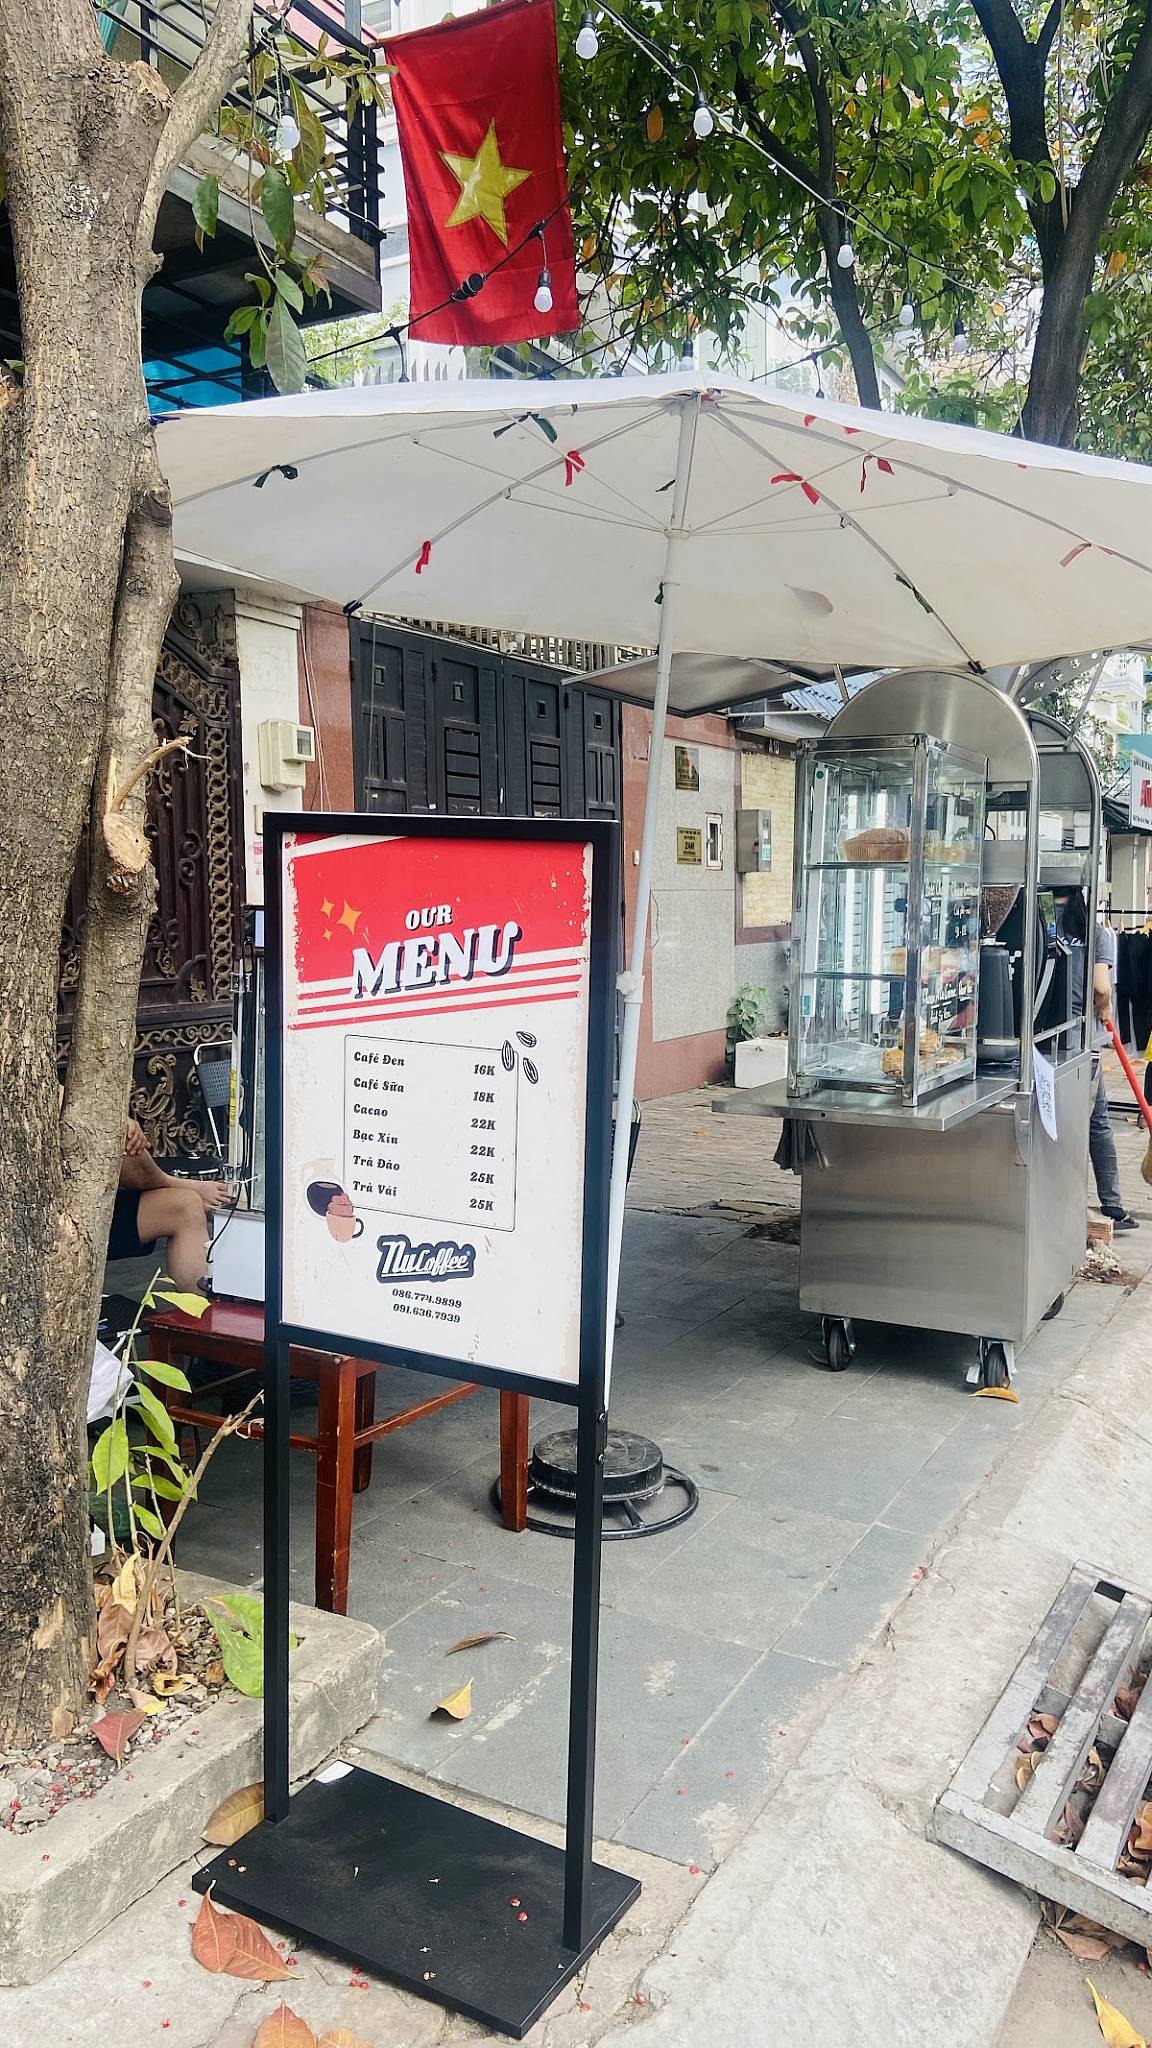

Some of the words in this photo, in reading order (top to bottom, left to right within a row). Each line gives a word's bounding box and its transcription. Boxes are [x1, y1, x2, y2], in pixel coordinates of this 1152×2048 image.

[405, 904, 453, 931] OUR
[352, 920, 523, 999] MENU
[354, 1051, 379, 1064] Café
[382, 1054, 405, 1066] Đen
[473, 1063, 496, 1076] 16K
[353, 1077, 379, 1090] Café
[382, 1080, 405, 1092] Sữa
[472, 1091, 495, 1103] 18K
[353, 1103, 388, 1117] Cacao
[470, 1118, 496, 1130] 22K
[352, 1129, 374, 1142] Bạc
[470, 1145, 495, 1157] 22K
[469, 1171, 495, 1184] 25K
[469, 1198, 495, 1211] 25K
[392, 1288, 462, 1308] 086.774.9899
[393, 1303, 461, 1323] 091.636.7939
